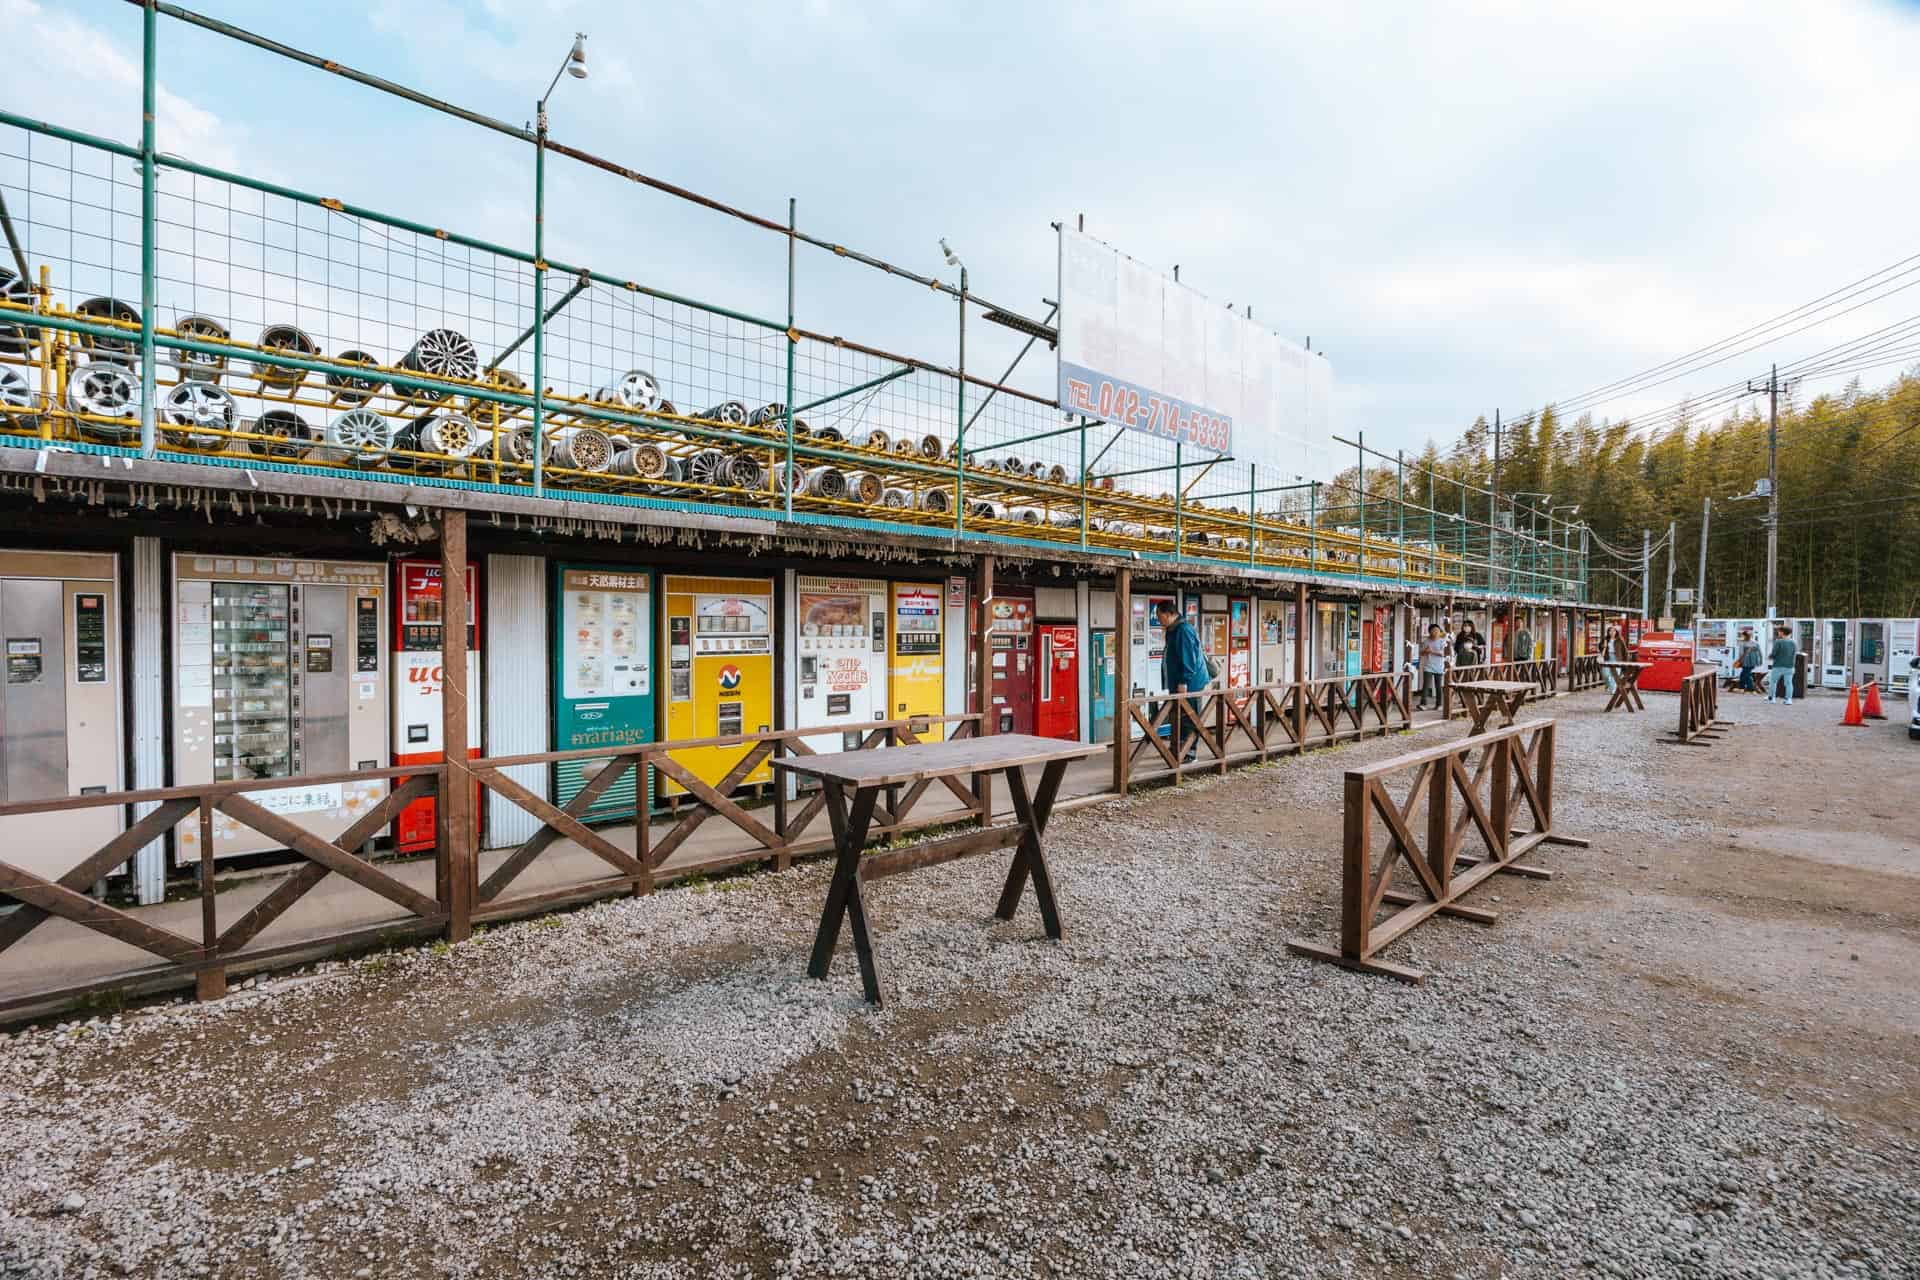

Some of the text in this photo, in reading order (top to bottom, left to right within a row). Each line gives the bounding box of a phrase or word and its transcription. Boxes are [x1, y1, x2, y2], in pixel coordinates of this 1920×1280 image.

[1099, 381, 1229, 452] 042-714-5333
[408, 666, 443, 682] UC
[571, 723, 645, 745] mariage
